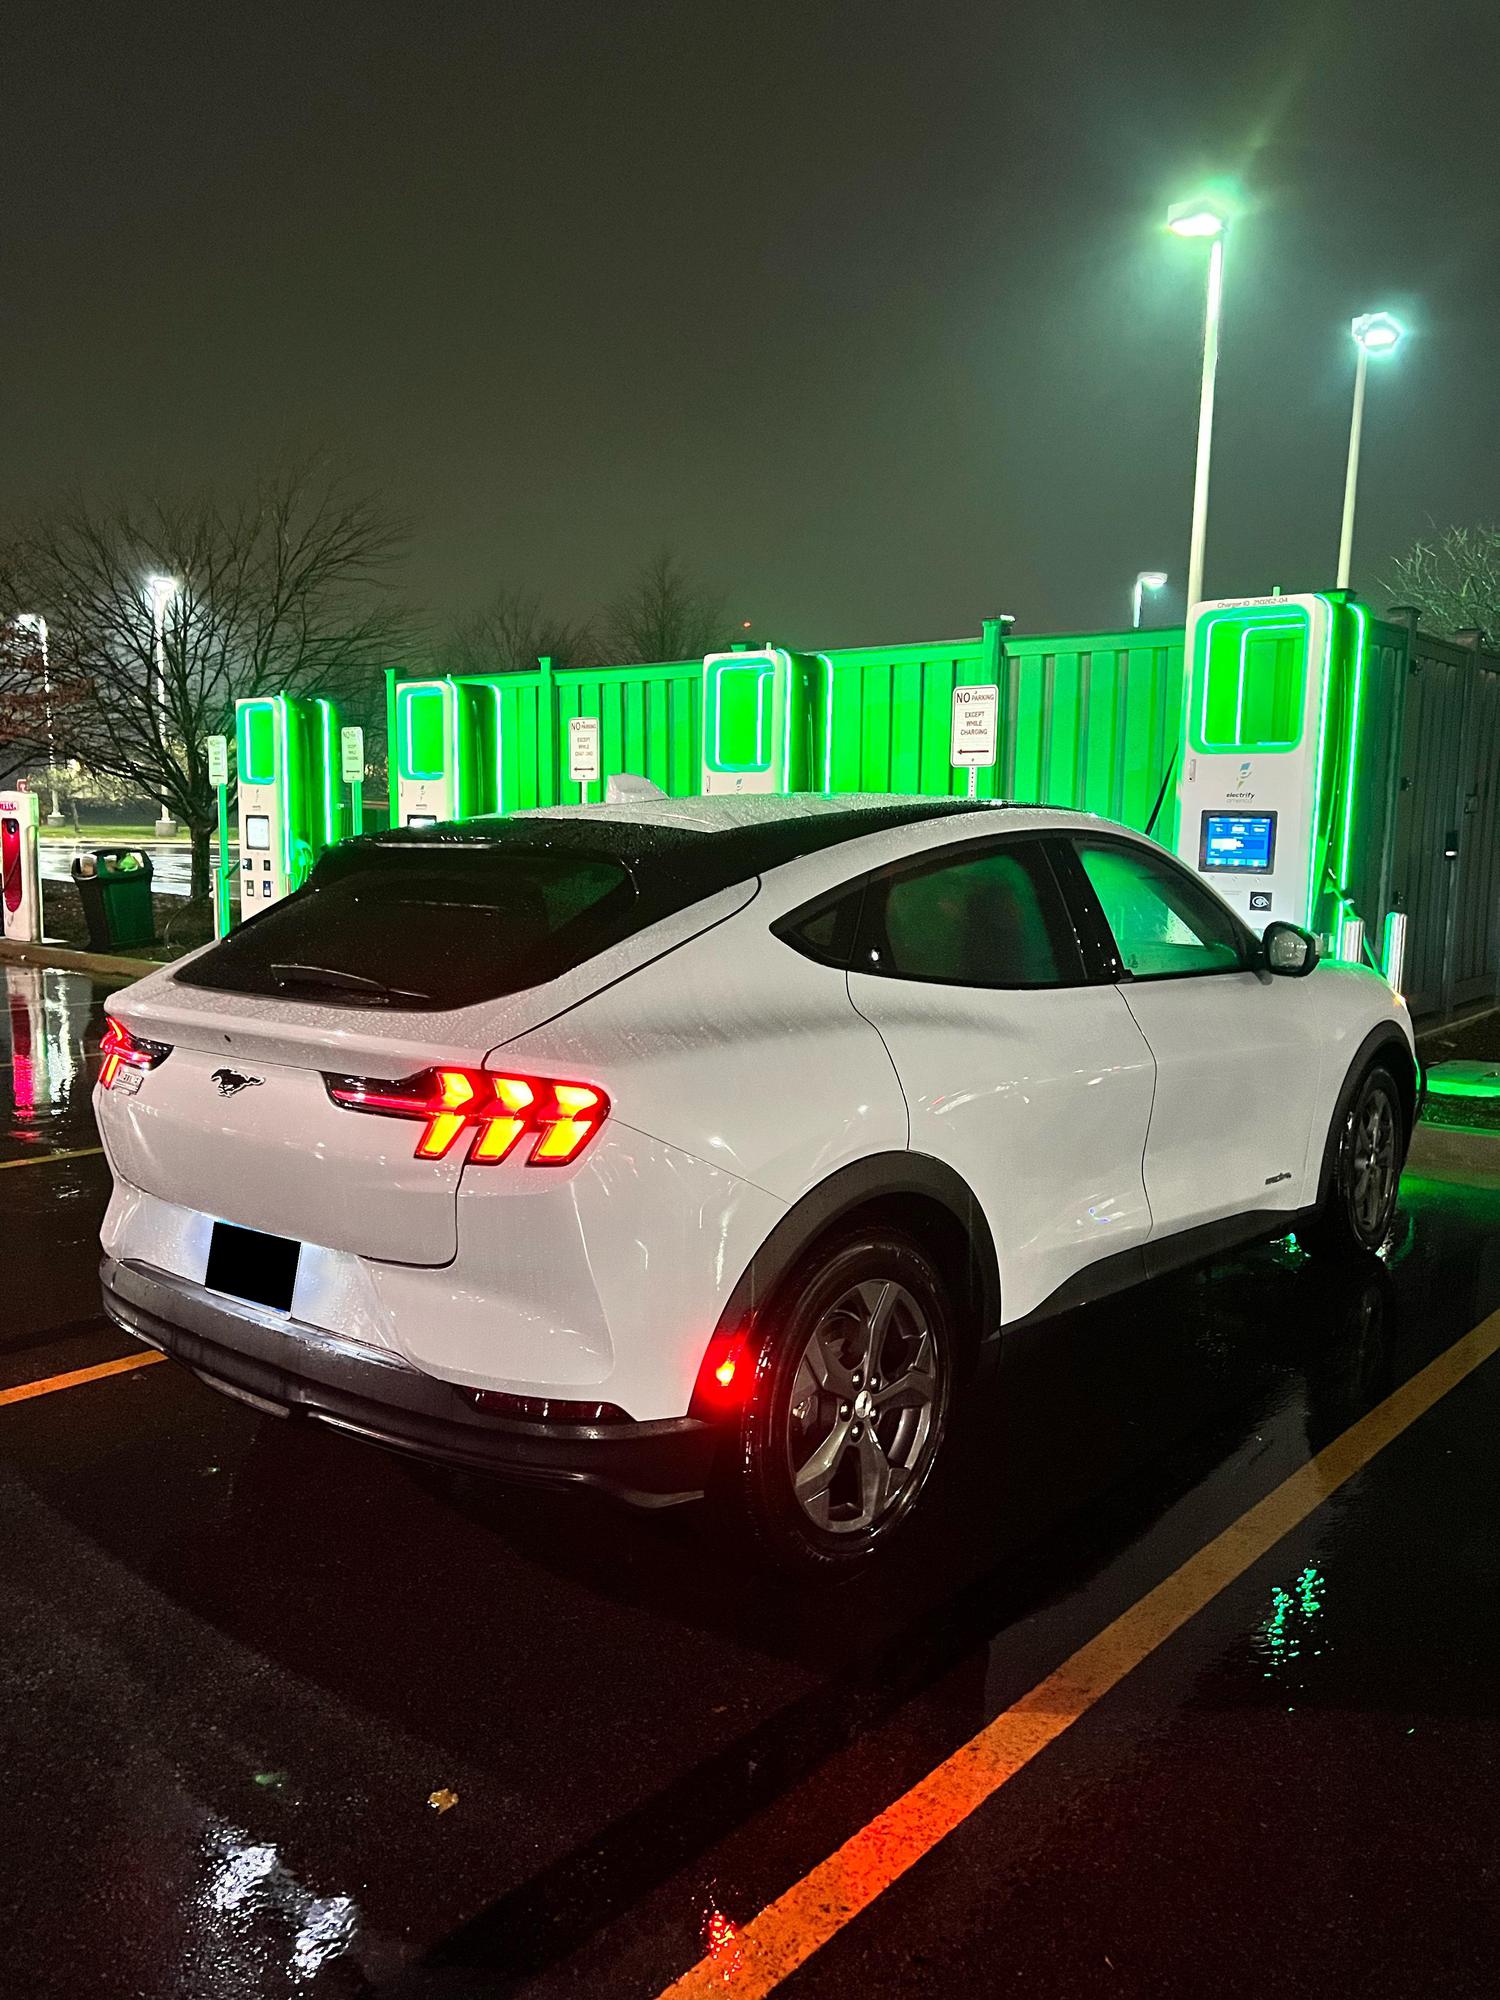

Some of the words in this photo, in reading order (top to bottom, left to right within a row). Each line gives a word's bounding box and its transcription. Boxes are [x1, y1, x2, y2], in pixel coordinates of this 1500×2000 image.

[956, 692, 971, 703] NO
[571, 722, 581, 731] NO
[960, 728, 988, 736] CHARGING
